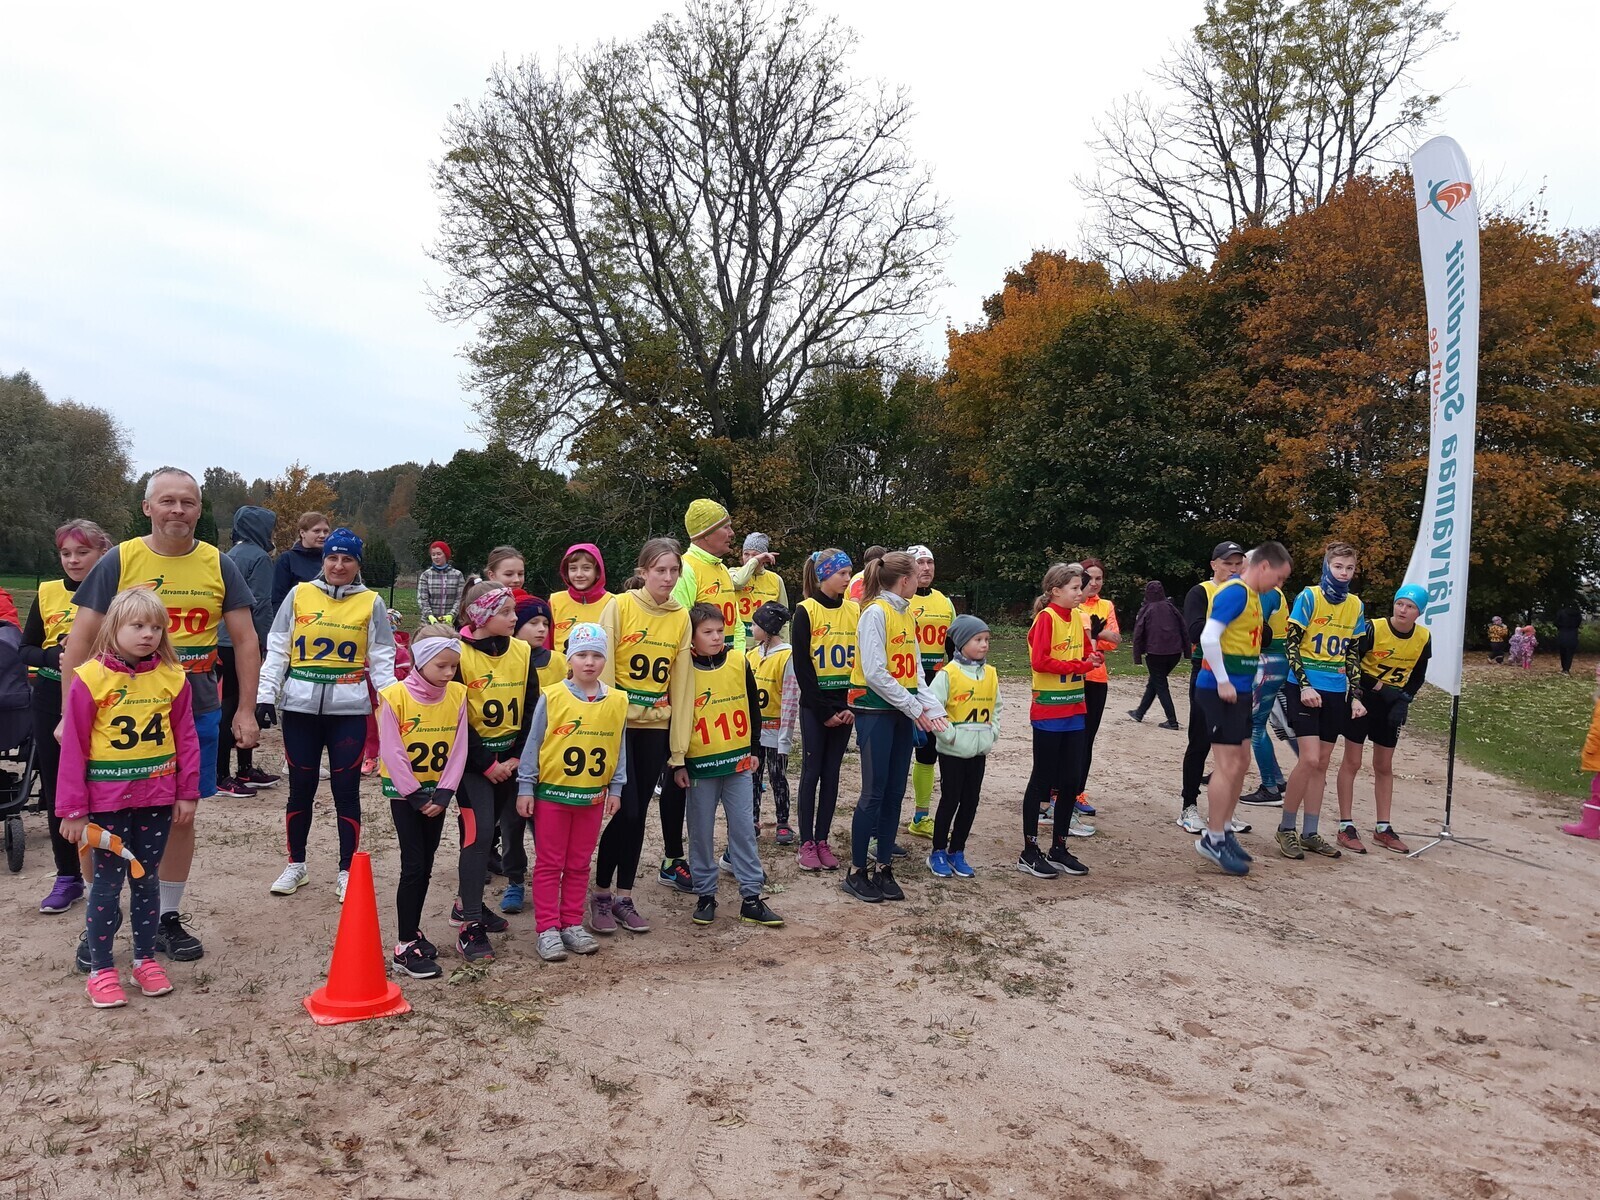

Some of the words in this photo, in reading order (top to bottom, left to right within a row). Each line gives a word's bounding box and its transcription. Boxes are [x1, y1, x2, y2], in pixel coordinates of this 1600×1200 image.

[165, 607, 210, 635] 50
[294, 635, 358, 663] 129
[292, 667, 357, 681] www.jarvasport.ee
[629, 653, 671, 684] 96
[891, 653, 914, 679] 30
[1377, 664, 1407, 684] 75
[482, 697, 519, 728] 91
[694, 709, 749, 745] 119
[110, 713, 166, 750] 34
[406, 741, 450, 773] 28
[563, 746, 607, 777] 93
